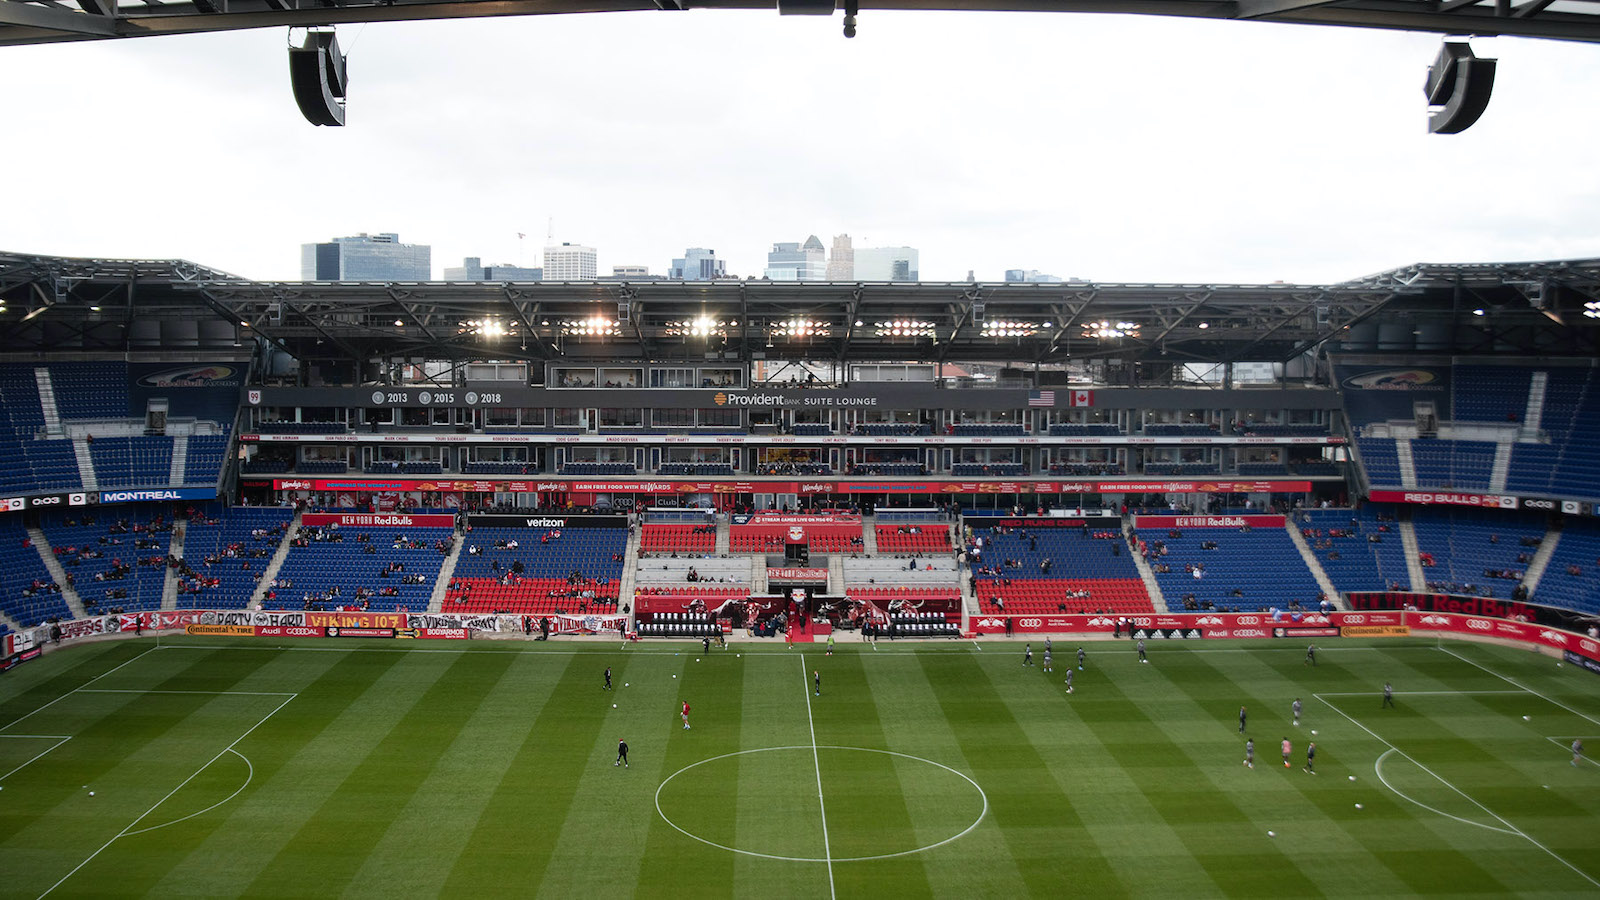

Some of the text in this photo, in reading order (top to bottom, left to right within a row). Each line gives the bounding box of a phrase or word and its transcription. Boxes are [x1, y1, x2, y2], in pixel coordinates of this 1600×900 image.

[388, 394, 408, 403] 2013
[434, 394, 454, 403] 2015
[480, 394, 502, 403] 2018
[728, 393, 784, 406] Provident
[804, 398, 832, 406] SUITE
[836, 398, 876, 406] LOUNGE
[104, 490, 182, 502] MONTREAL
[1404, 494, 1432, 502] RED
[1435, 494, 1480, 504] BULLS
[342, 516, 412, 525] NEW YORK Red Bulls
[527, 518, 564, 528] verizon
[1176, 518, 1189, 526] NEW
[1208, 518, 1224, 526] Red
[1225, 517, 1245, 526] Bulls
[1434, 594, 1479, 615] Red
[218, 613, 302, 626] PARTY HARD
[310, 615, 399, 628] VIKING 107
[187, 625, 228, 634] Continental
